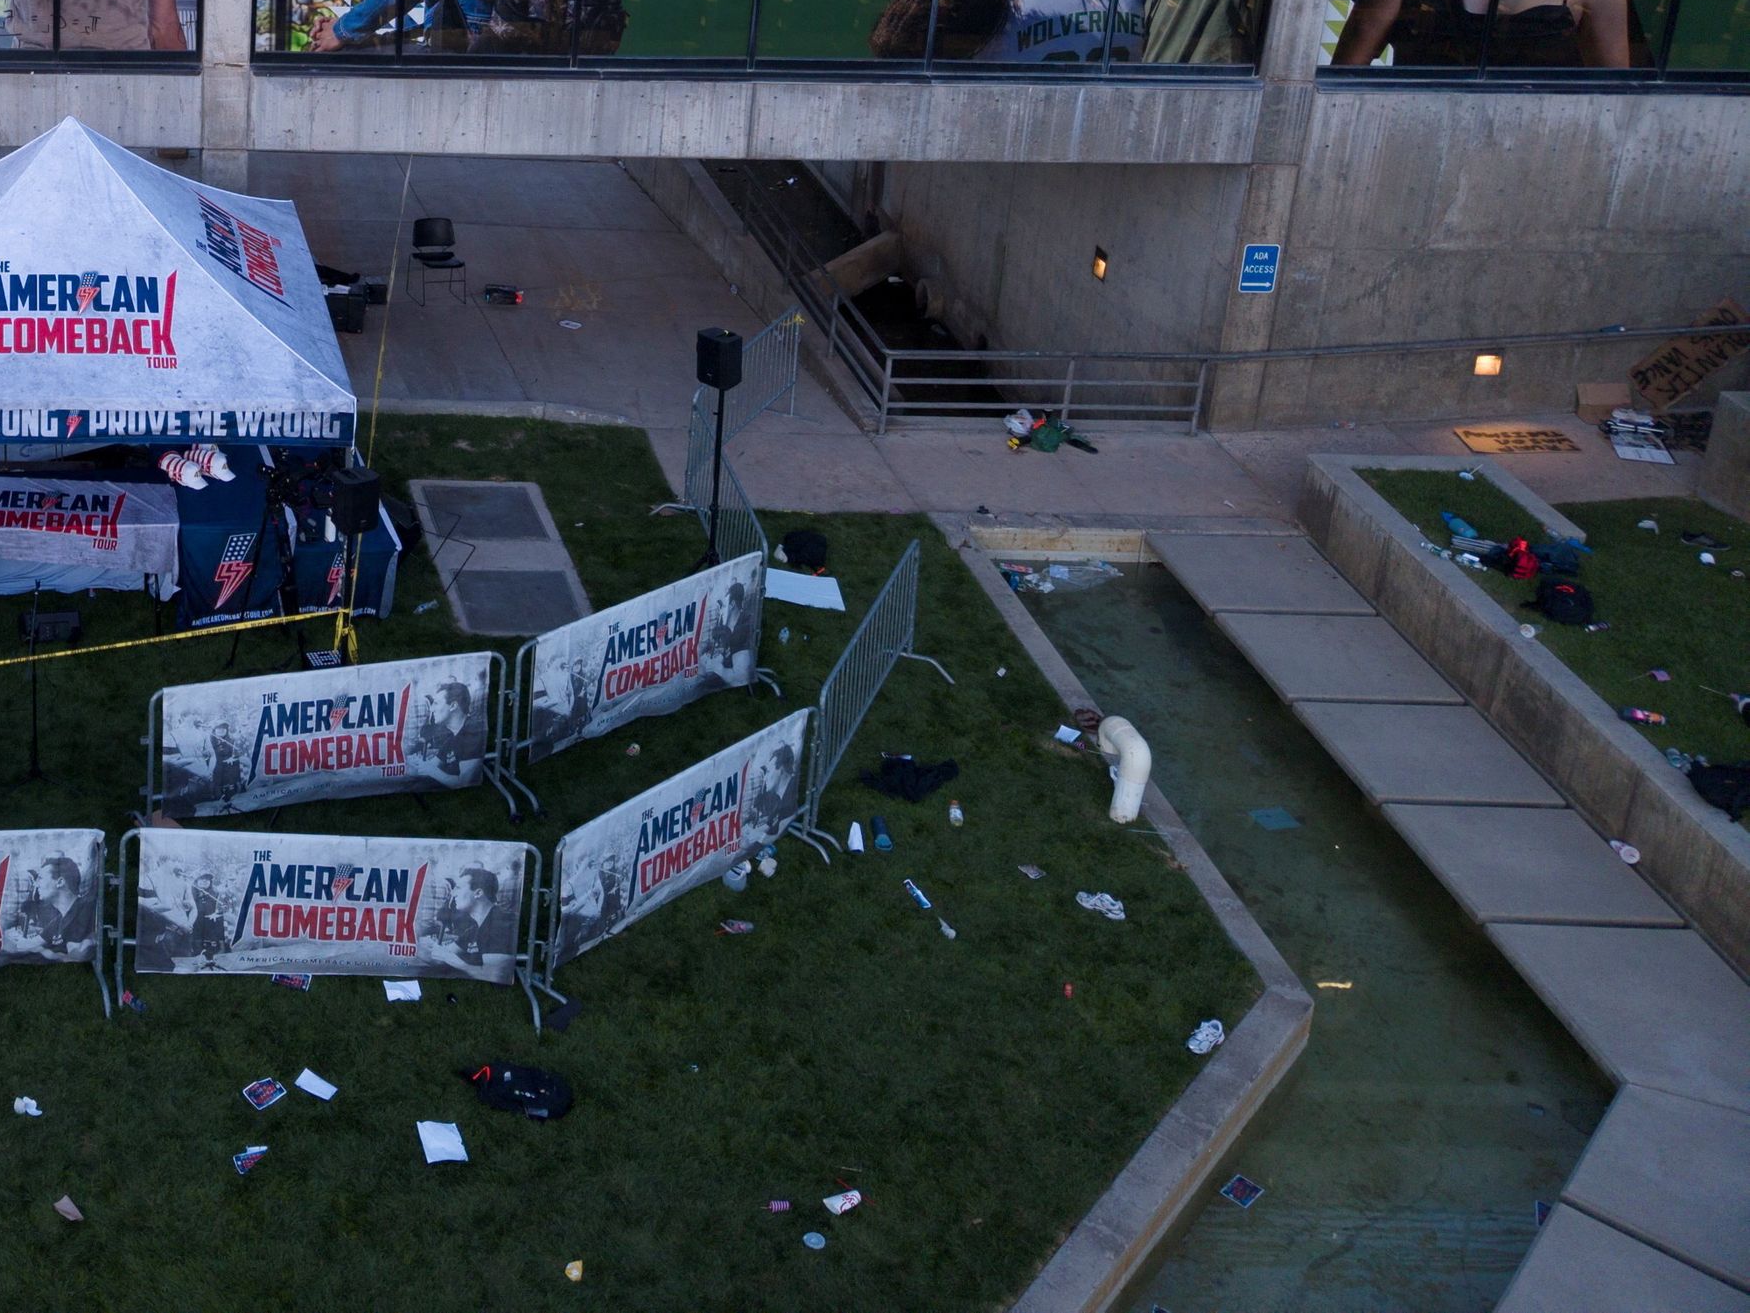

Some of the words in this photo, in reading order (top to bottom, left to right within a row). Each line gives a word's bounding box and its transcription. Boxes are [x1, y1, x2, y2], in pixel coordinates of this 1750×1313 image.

[1017, 11, 1146, 52] WOLVERINE
[1253, 252, 1269, 260] ADA
[1244, 265, 1274, 274] ACCESS
[146, 356, 177, 369] TOUR
[89, 410, 182, 436] PROVE
[188, 410, 227, 437] ME
[236, 411, 340, 438] WRONG
[92, 538, 118, 551] TOUR
[608, 622, 620, 635] THE
[604, 590, 708, 701] COMEBACK
[684, 666, 699, 680] OUR
[262, 692, 278, 705] THE
[263, 682, 411, 776] COMEBACK
[381, 765, 405, 778] TOUR
[641, 807, 654, 823] THE
[639, 759, 750, 895] COMEBACK
[253, 850, 272, 863] THE
[252, 862, 429, 945] COMEBACK
[388, 943, 416, 957] TOUR
